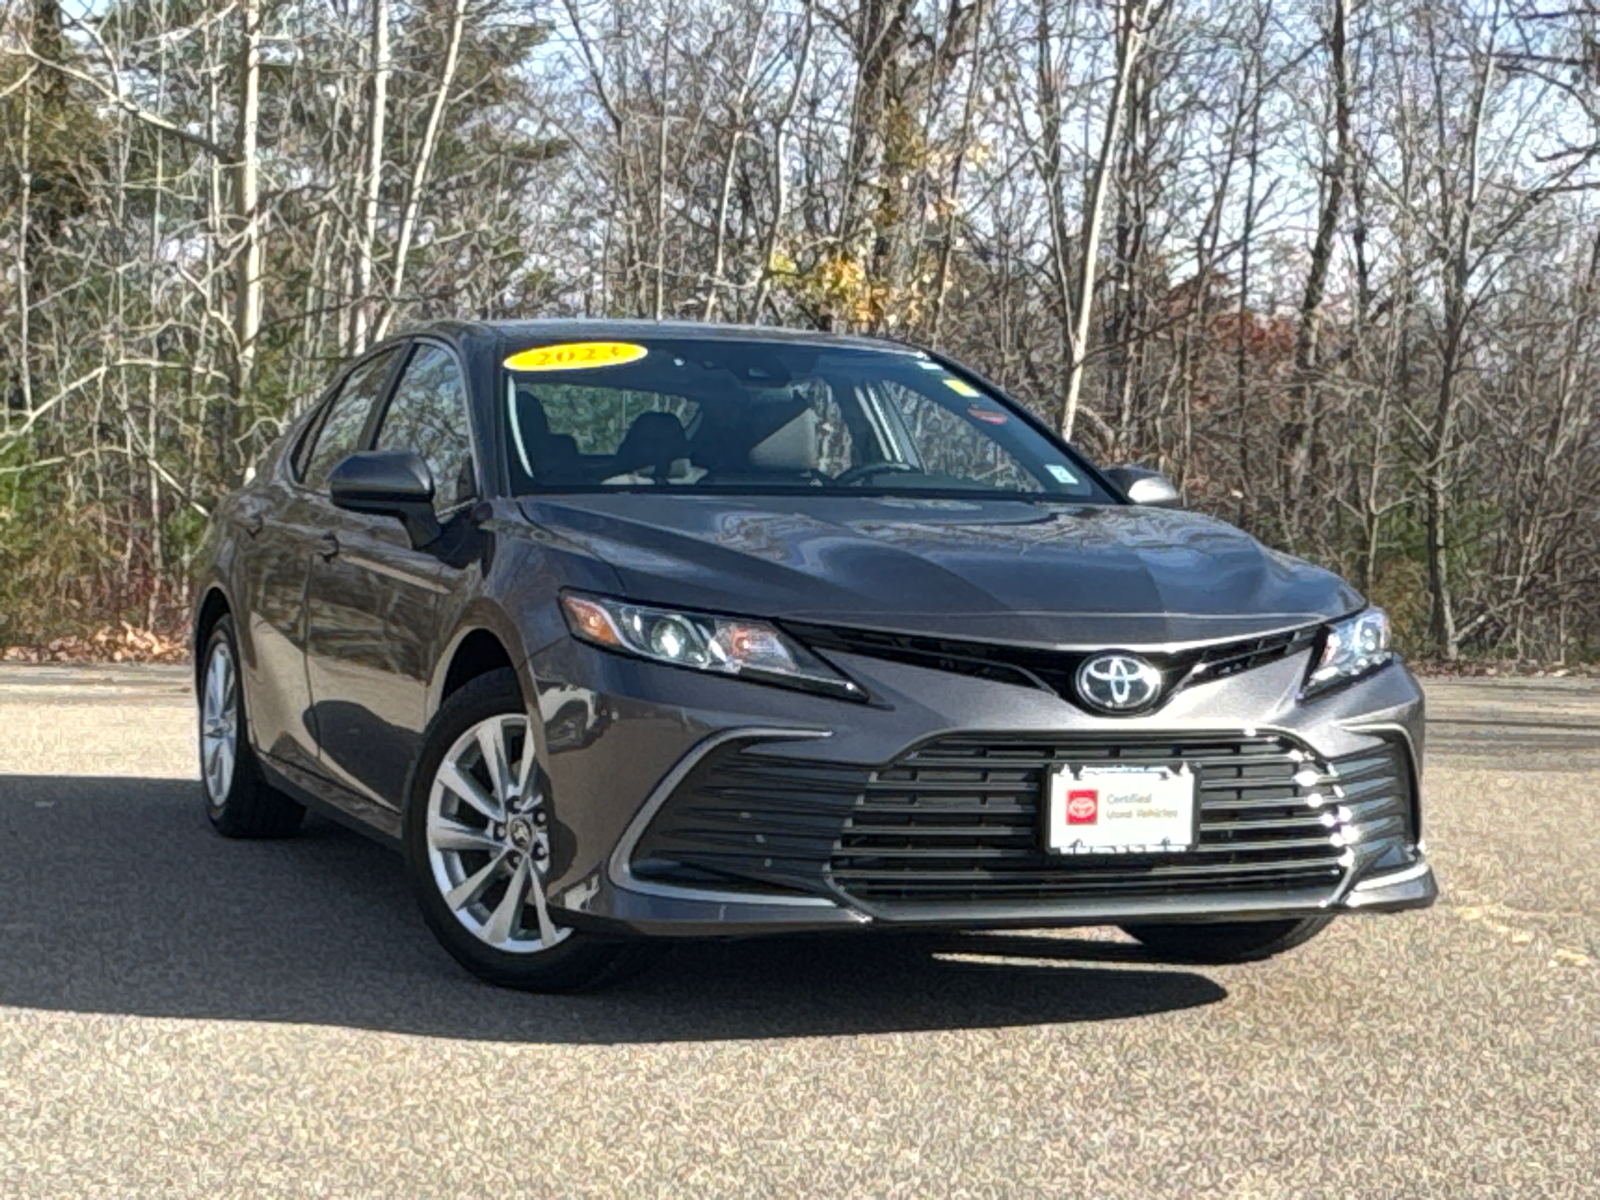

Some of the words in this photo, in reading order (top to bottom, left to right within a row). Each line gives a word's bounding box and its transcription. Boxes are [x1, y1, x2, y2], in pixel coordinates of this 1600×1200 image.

[1106, 793, 1153, 805] Certified
[1106, 809, 1133, 820] Used
[1136, 807, 1179, 819] Vehicles
